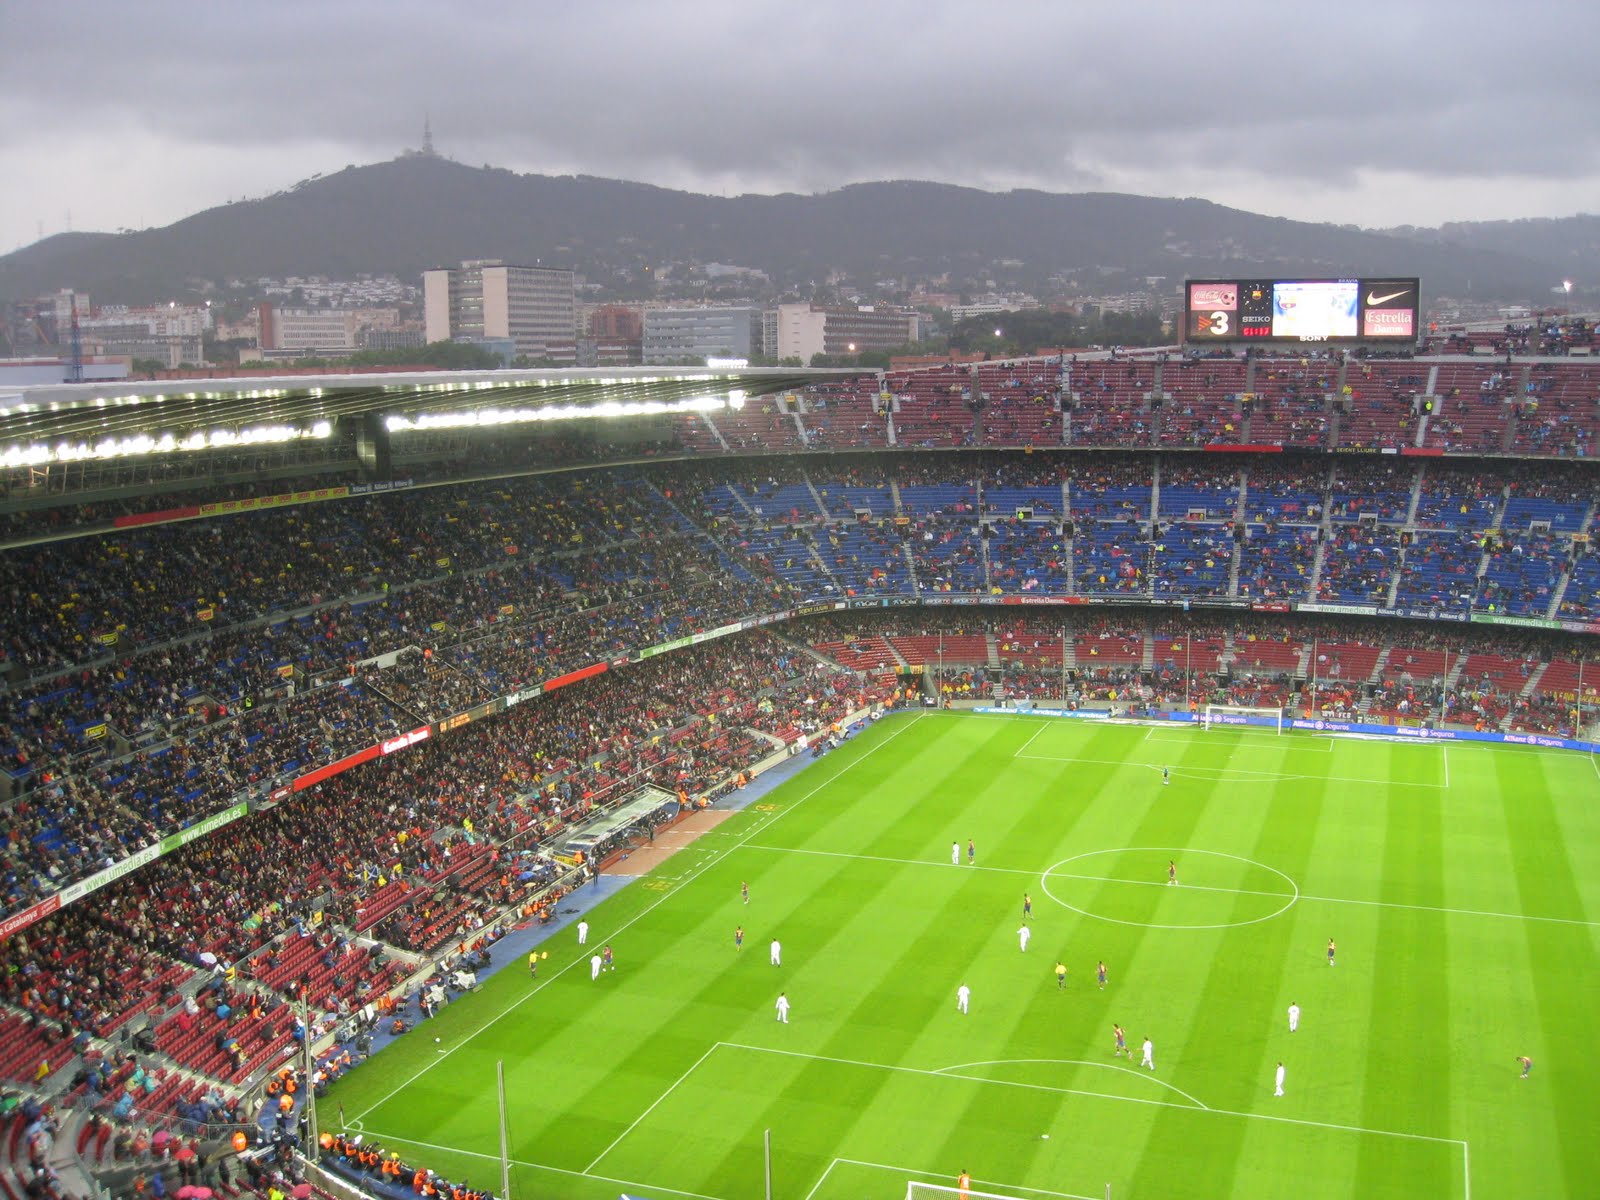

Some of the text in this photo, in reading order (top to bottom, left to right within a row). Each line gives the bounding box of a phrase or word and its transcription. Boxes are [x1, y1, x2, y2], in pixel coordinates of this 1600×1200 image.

[1209, 311, 1229, 335] 3
[1242, 315, 1271, 323] SEIKO
[1365, 311, 1412, 324] Estrella
[1374, 324, 1404, 333] Damm
[1493, 617, 1555, 628] www.umedia.es
[1223, 715, 1247, 724] Seguros
[1292, 720, 1350, 731] Allianz Seguros
[1429, 730, 1455, 738] Seguros
[1503, 735, 1563, 747] Allianz Seguros
[180, 808, 242, 844] www.umedia.es
[84, 850, 154, 892] www.umedia.es
[4, 910, 39, 933] Catalunya
